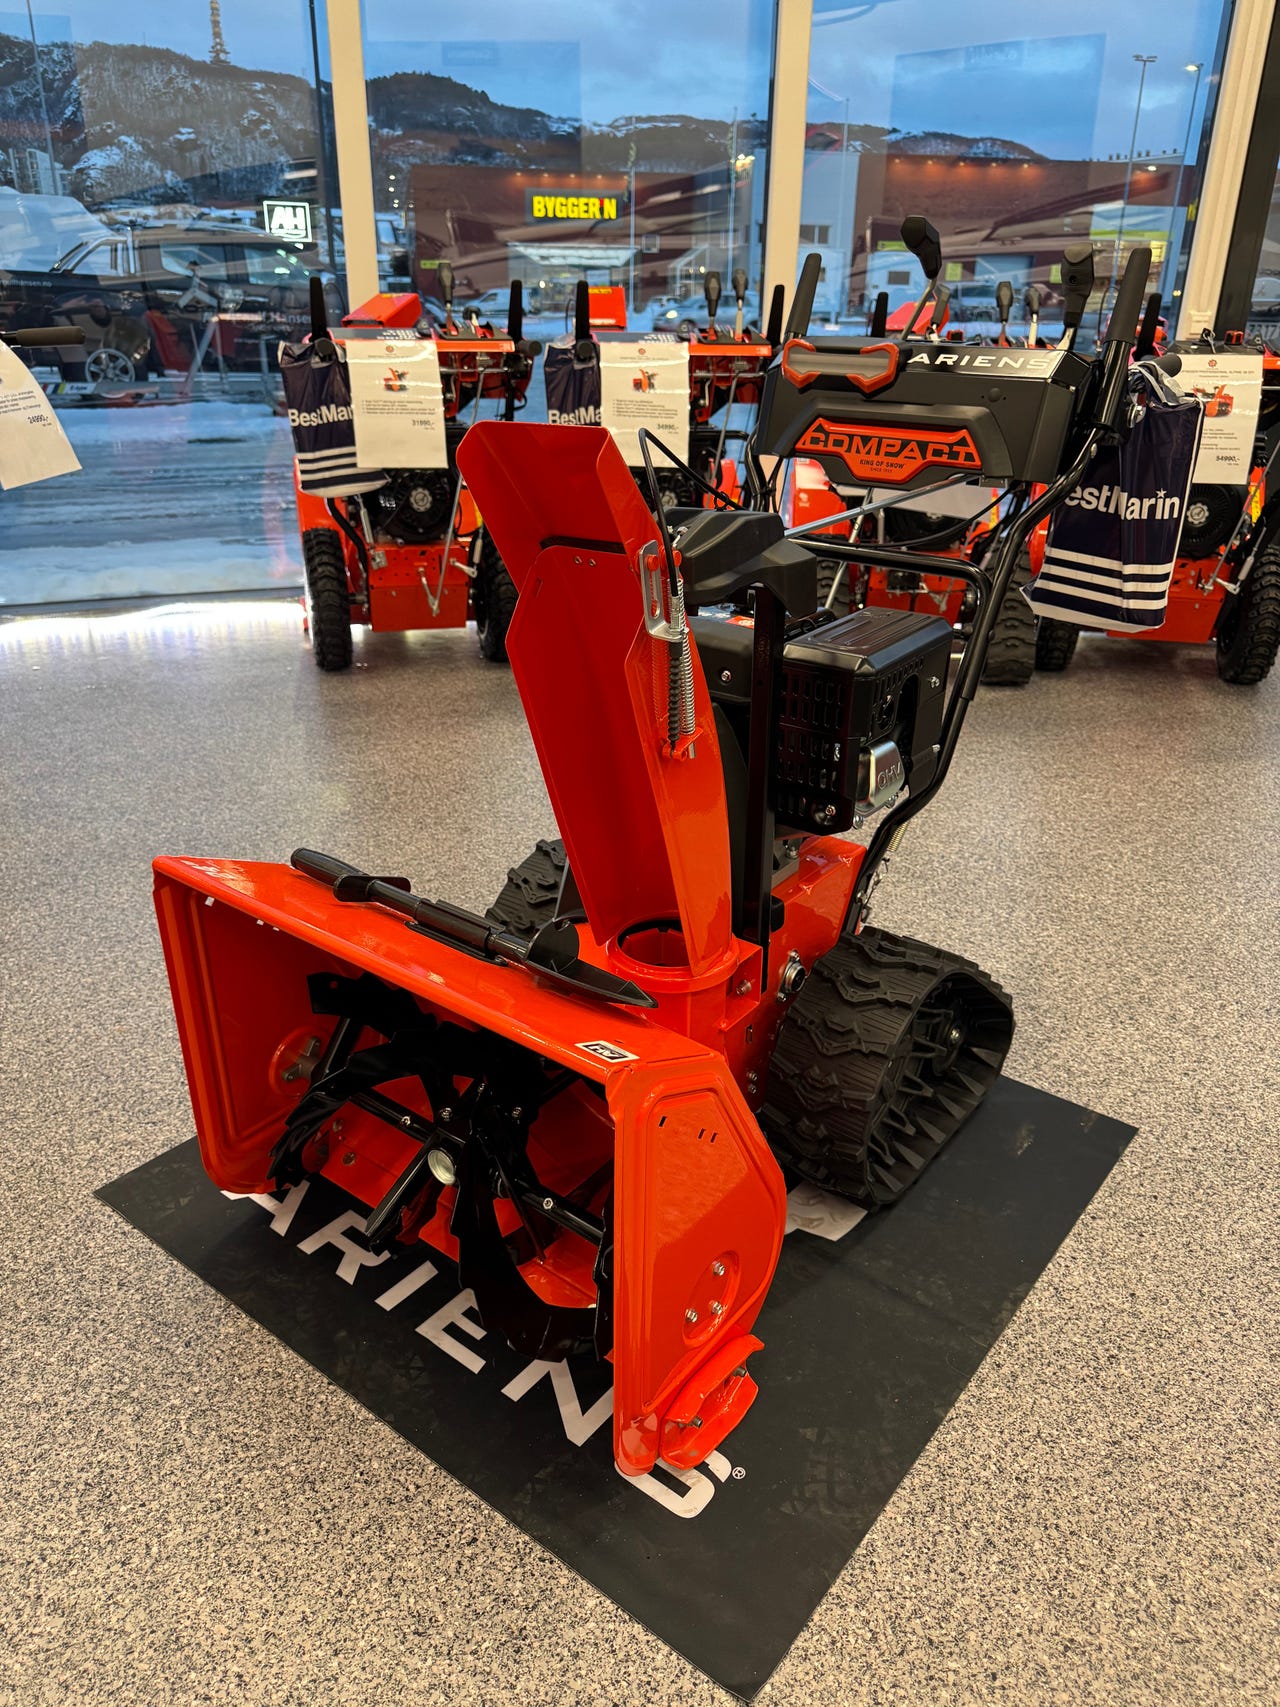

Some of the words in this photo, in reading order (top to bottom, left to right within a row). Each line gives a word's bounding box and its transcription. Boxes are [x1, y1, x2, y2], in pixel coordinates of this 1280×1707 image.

[907, 353, 1053, 370] ARIENS
[805, 432, 973, 463] COMPACT
[877, 762, 902, 790] OHV
